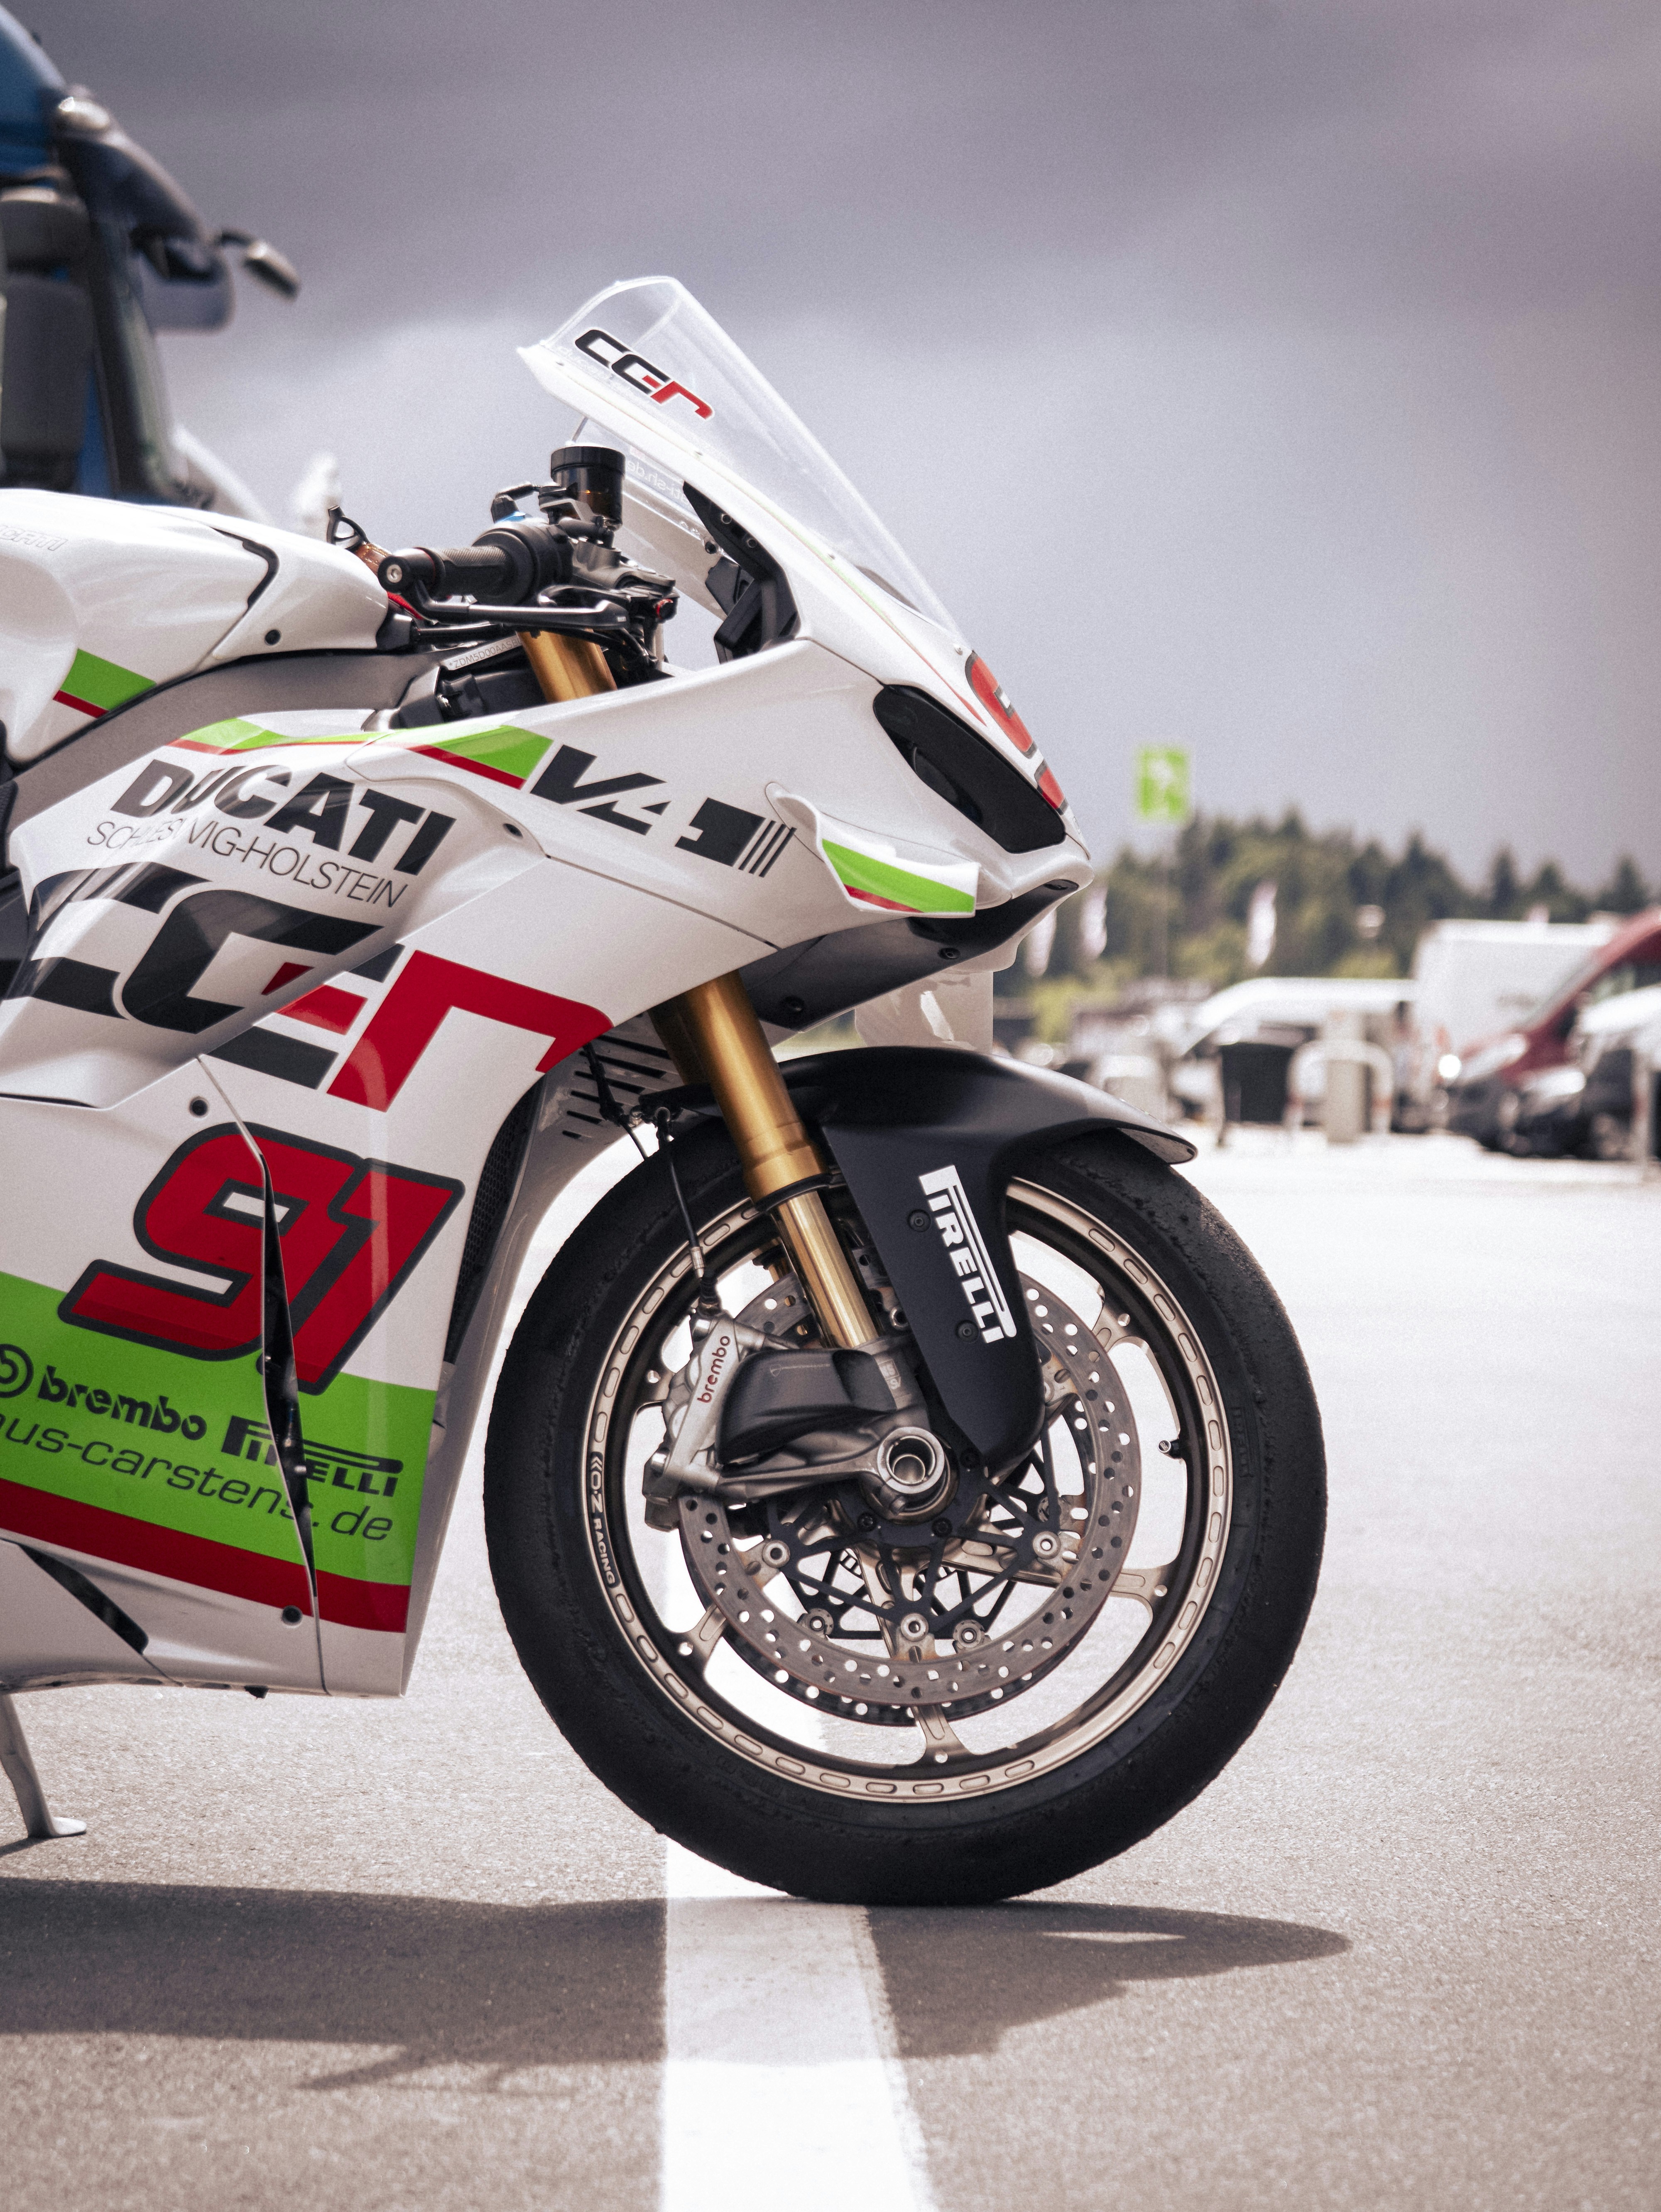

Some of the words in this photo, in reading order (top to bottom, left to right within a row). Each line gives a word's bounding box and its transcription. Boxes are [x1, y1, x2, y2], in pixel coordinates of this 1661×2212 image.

[110, 759, 456, 876] DUCATI
[88, 818, 408, 908] SCHLESWIG-HOLSTEIN
[58, 1121, 465, 1395] 91
[919, 1165, 1017, 1343] PIRELLI
[37, 1365, 207, 1440] brembo
[697, 1335, 731, 1404] brembo
[593, 1518, 615, 1585] RACING
